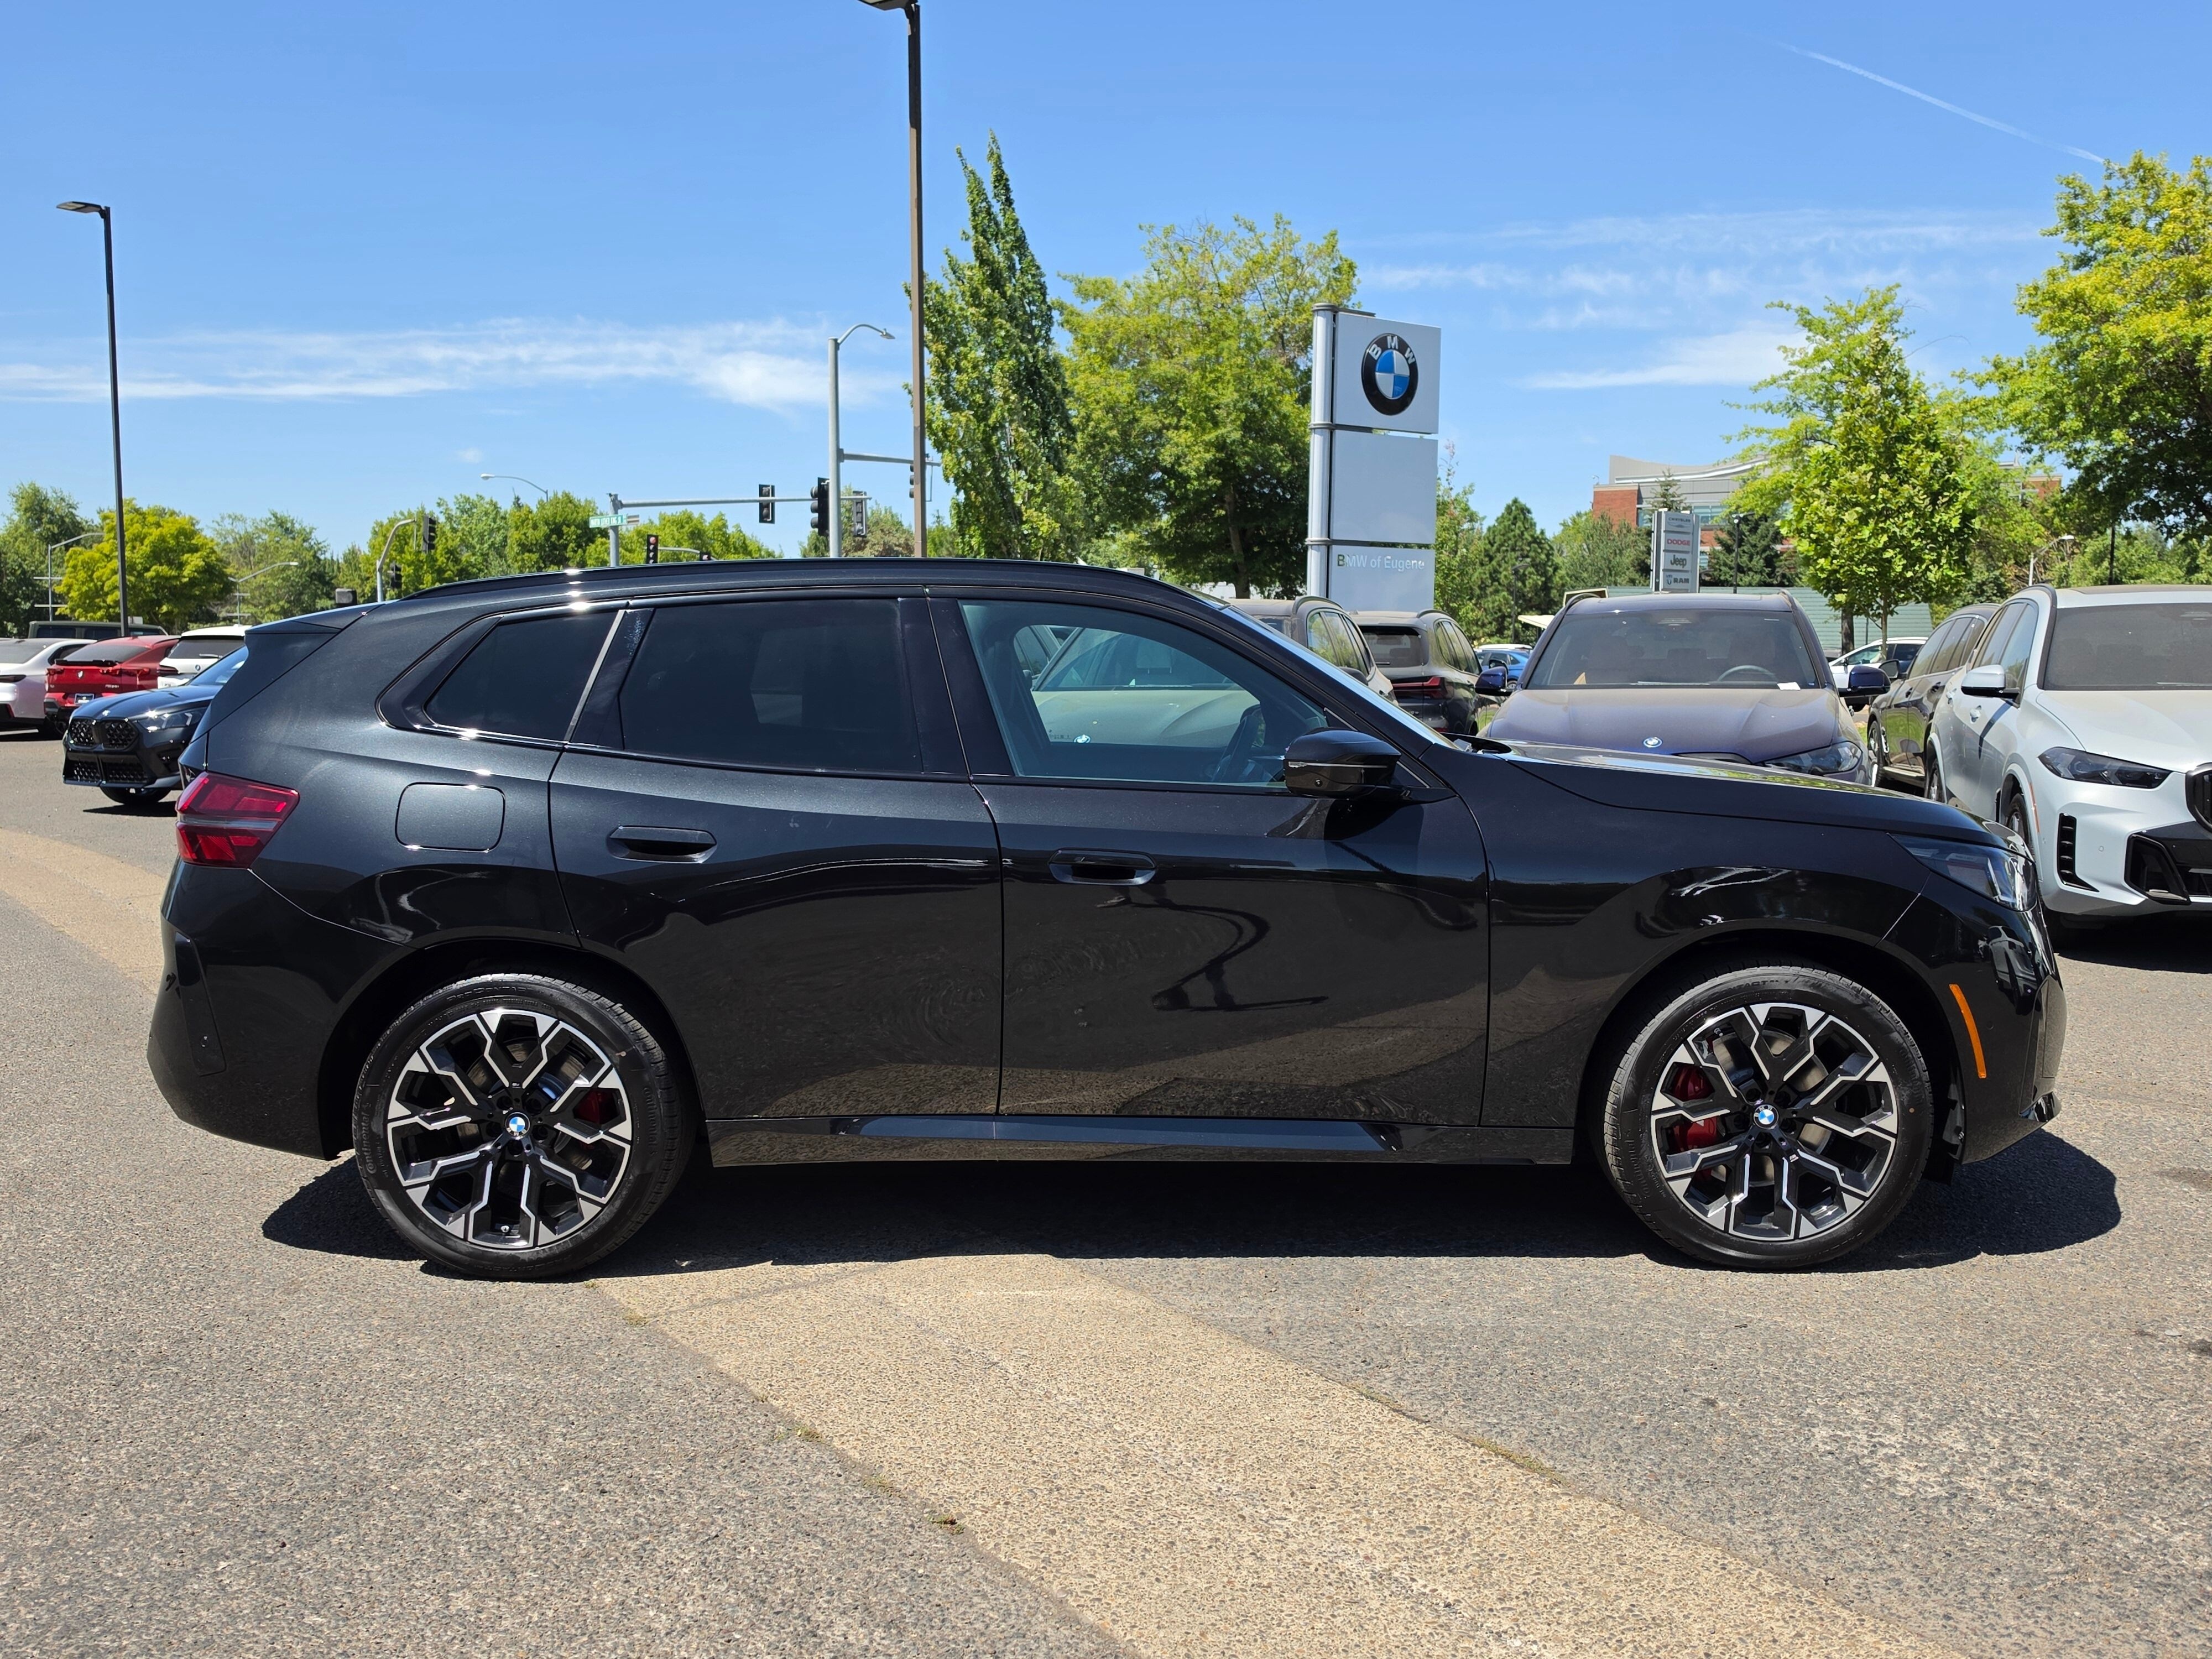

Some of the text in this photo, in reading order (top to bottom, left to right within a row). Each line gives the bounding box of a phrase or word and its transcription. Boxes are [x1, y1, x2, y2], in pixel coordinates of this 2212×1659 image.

[1369, 335, 1416, 365] BMW
[1337, 554, 1425, 572] BMW of Eugene
[1670, 555, 1687, 568] Jeep
[361, 1111, 378, 1175] Continental
